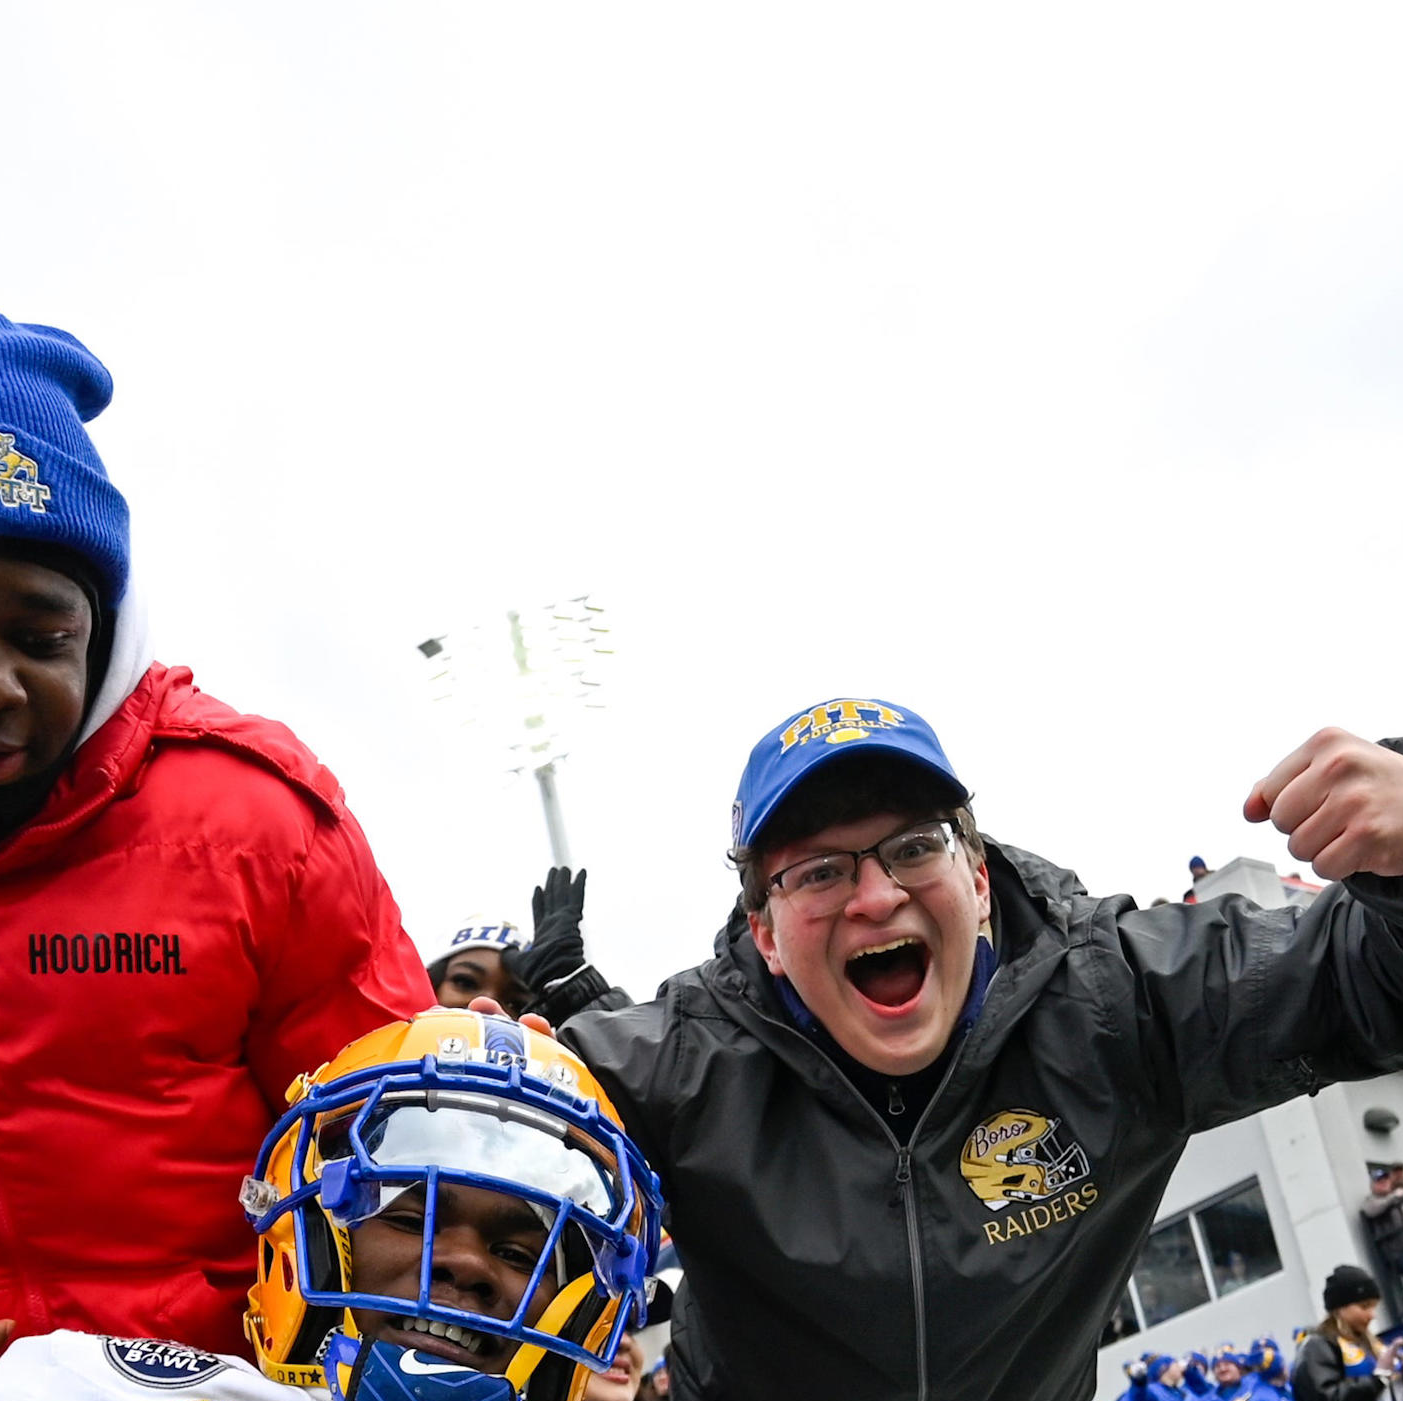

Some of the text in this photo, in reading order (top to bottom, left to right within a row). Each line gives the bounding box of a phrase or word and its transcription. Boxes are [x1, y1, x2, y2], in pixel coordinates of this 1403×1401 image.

[780, 699, 906, 754] PITT
[799, 720, 892, 746] FOOTBALL
[972, 1121, 1028, 1157] Boro
[982, 1181, 1099, 1245] RAIDERS
